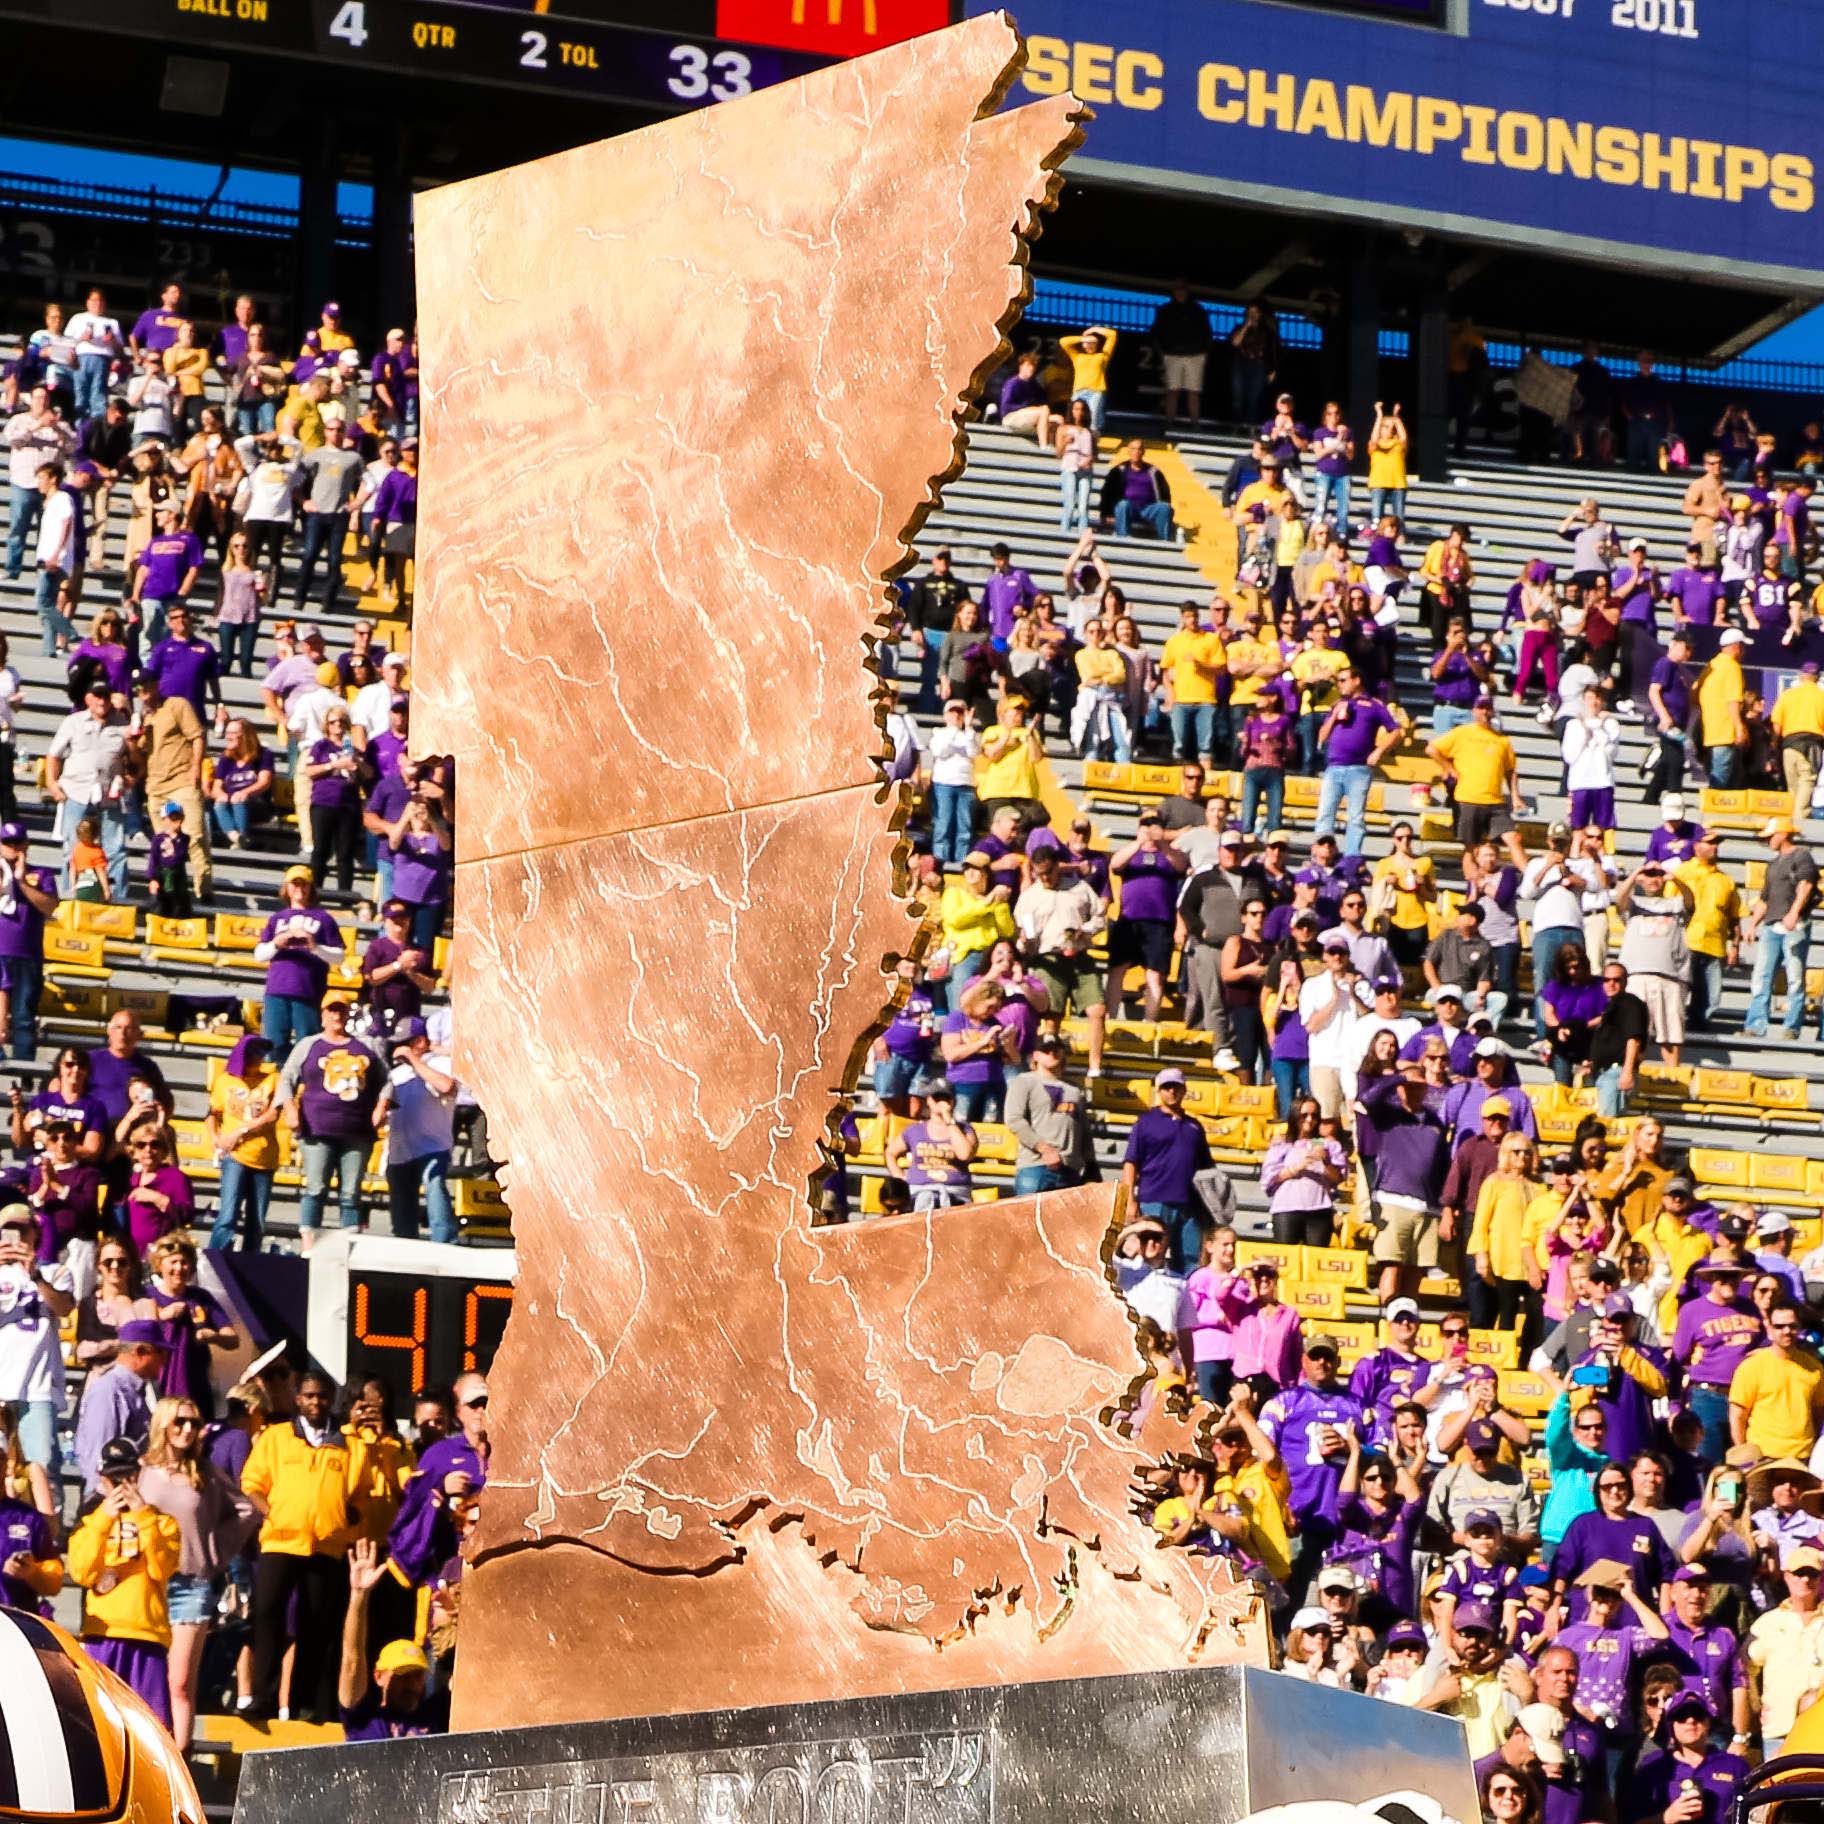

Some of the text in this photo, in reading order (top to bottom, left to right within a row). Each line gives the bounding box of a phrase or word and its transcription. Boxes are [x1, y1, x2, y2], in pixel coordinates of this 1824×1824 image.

[237, 0, 268, 21] ON
[1612, 0, 1699, 38] 2011
[329, 2, 456, 49] 4 QTR
[519, 32, 599, 69] 2 TOL
[667, 45, 753, 98] 33
[1021, 36, 1814, 212] SEC CHAMPIONSHIPS
[274, 915, 319, 934] LSU
[1317, 1259, 1353, 1271] LSU
[1294, 1292, 1330, 1306] LSU
[1507, 1380, 1544, 1394] LSU
